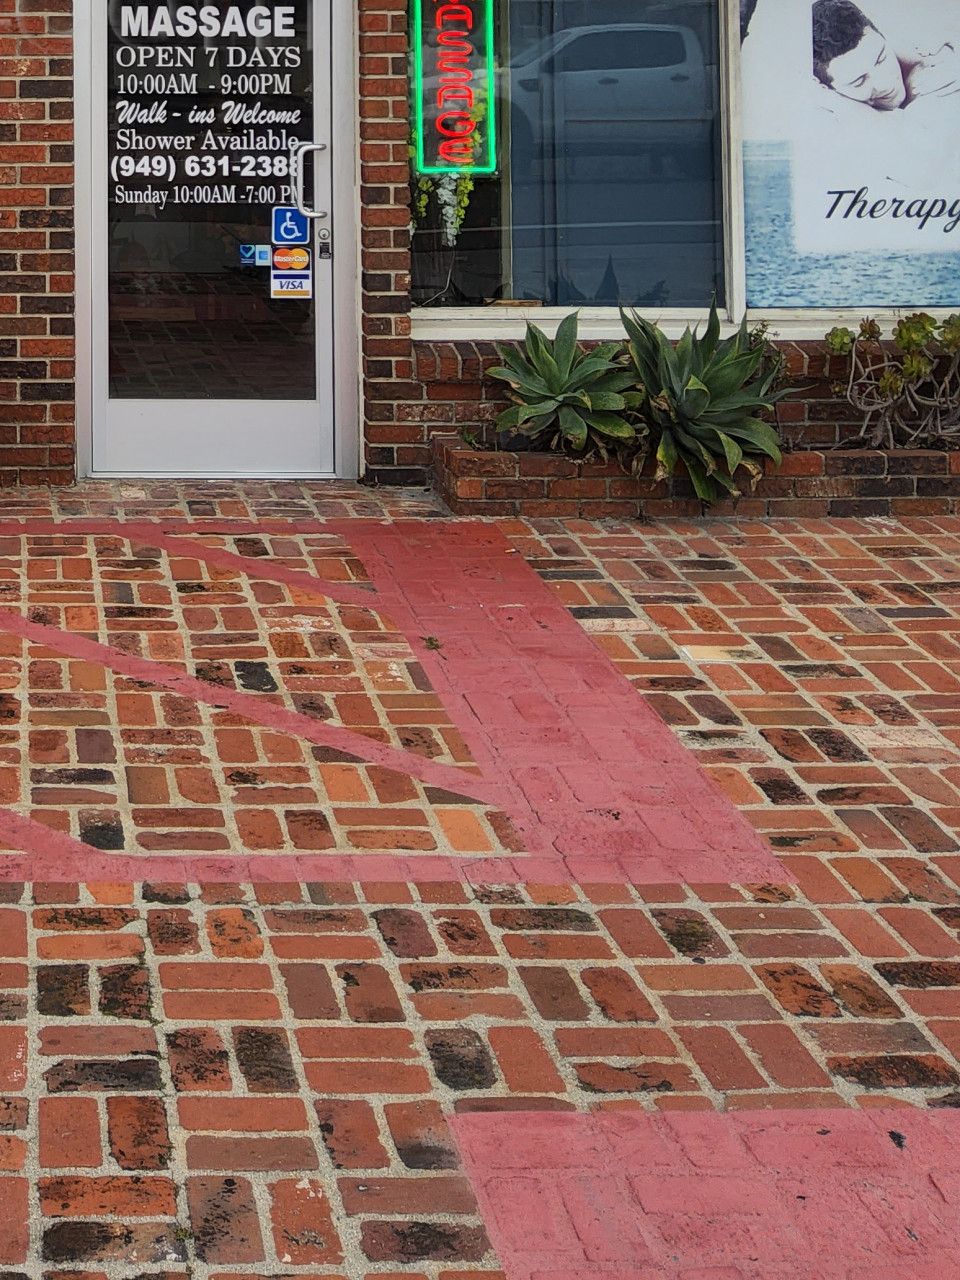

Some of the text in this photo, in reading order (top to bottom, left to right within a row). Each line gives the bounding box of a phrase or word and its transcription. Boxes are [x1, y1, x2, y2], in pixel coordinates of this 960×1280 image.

[120, 4, 296, 38] MASSAGE
[115, 46, 302, 68] OPEN 7 DAYS
[117, 73, 198, 95] 10:00AM
[220, 73, 292, 95] 9:00PM
[115, 100, 168, 125] Walk
[188, 105, 216, 125] ins
[221, 100, 302, 125] Welcome
[116, 129, 300, 151] Shower Available
[110, 155, 176, 182] (949)
[115, 186, 169, 210] Sunday
[172, 185, 237, 204] 10:00AM
[240, 185, 276, 204] -7:00
[825, 186, 960, 234] Therapy
[279, 280, 304, 290] VISA
